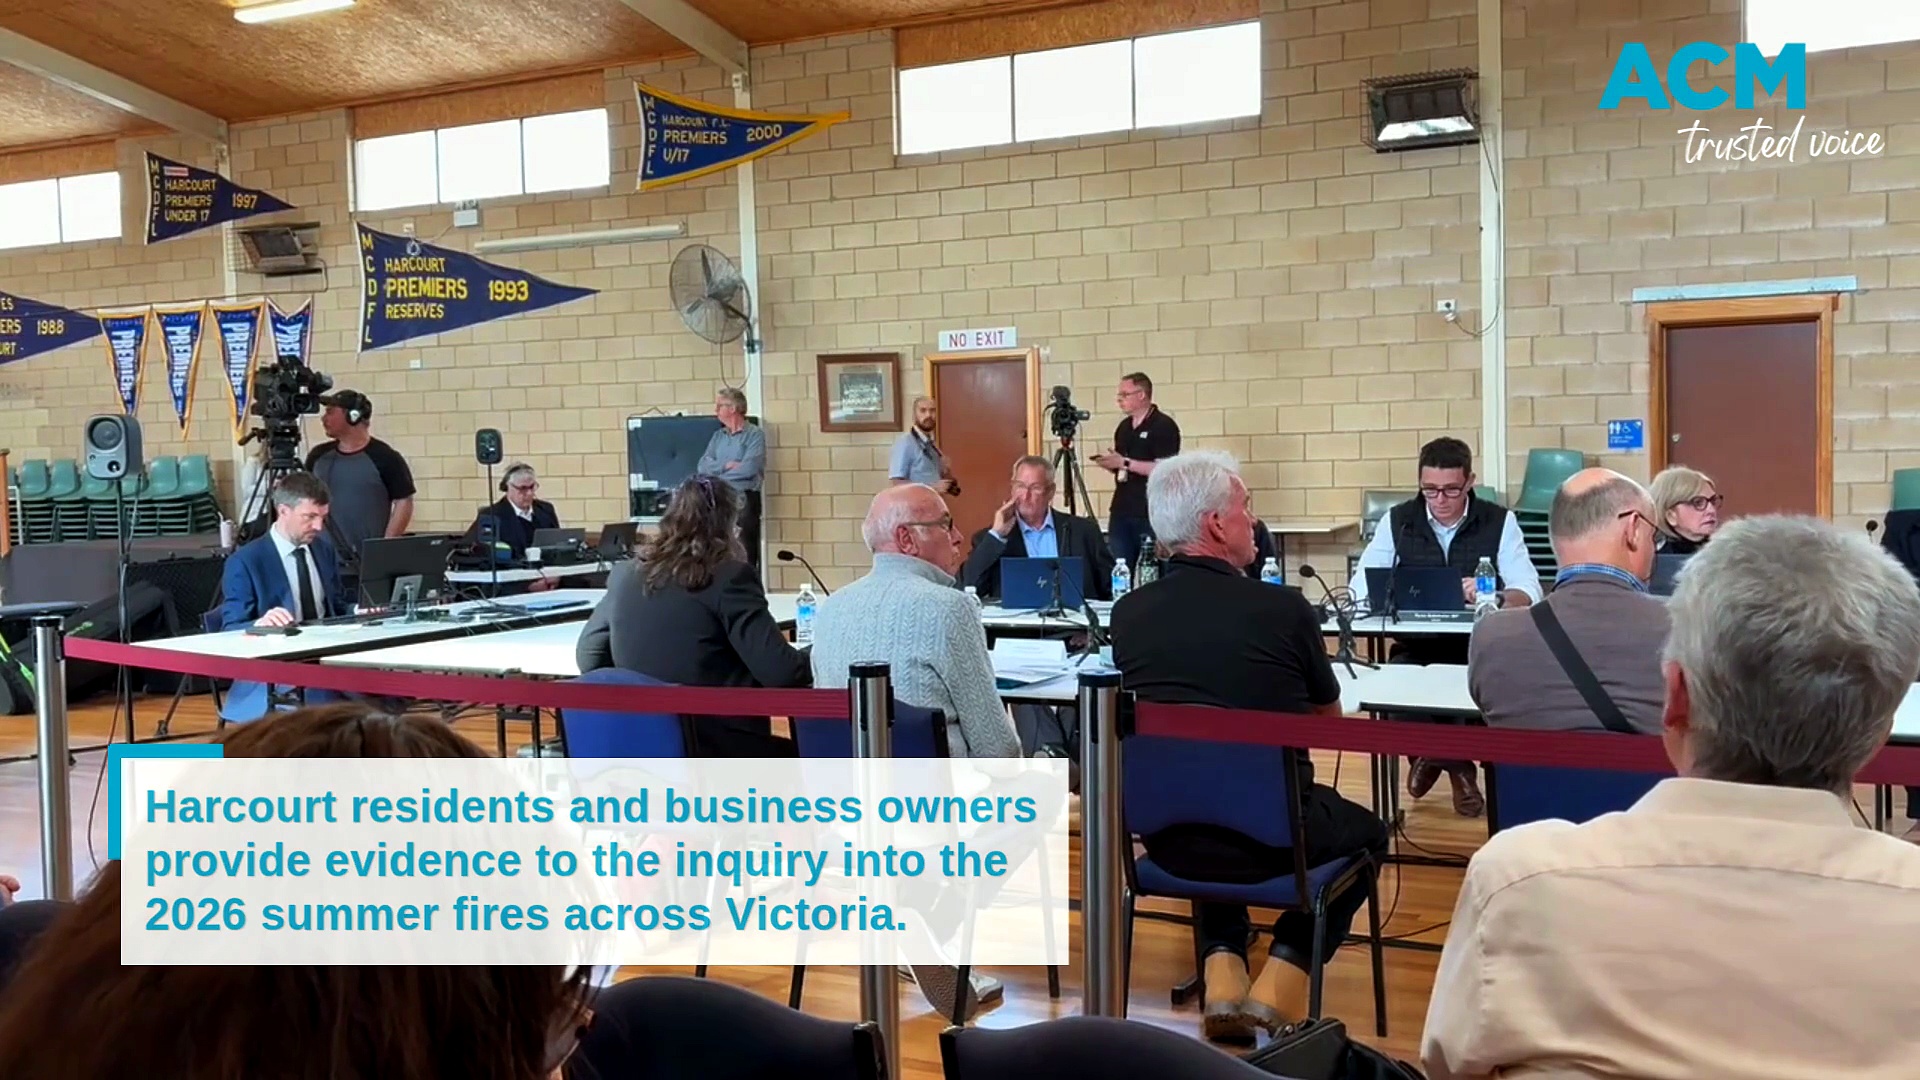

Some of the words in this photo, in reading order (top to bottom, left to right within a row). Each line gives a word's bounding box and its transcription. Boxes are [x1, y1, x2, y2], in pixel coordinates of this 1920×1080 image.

[663, 129, 728, 145] PREMIERS
[746, 125, 783, 142] 2000
[662, 147, 690, 164] U/17
[164, 179, 216, 191] HARCOURT
[164, 195, 213, 207] PREMIERS
[232, 193, 258, 209] 1997
[164, 209, 197, 222] UNDER
[200, 210, 210, 222] 17
[384, 257, 446, 274] HARCOURT
[386, 278, 468, 300] PREMIERS
[488, 280, 529, 302] 1993
[385, 304, 445, 320] RESERVES
[37, 319, 65, 336] 1988
[949, 334, 967, 348] NO
[976, 330, 1005, 346] EXIT
[111, 329, 136, 401] PREMIERS
[164, 325, 192, 397] PREMIERS
[221, 321, 250, 397] PREMIERS
